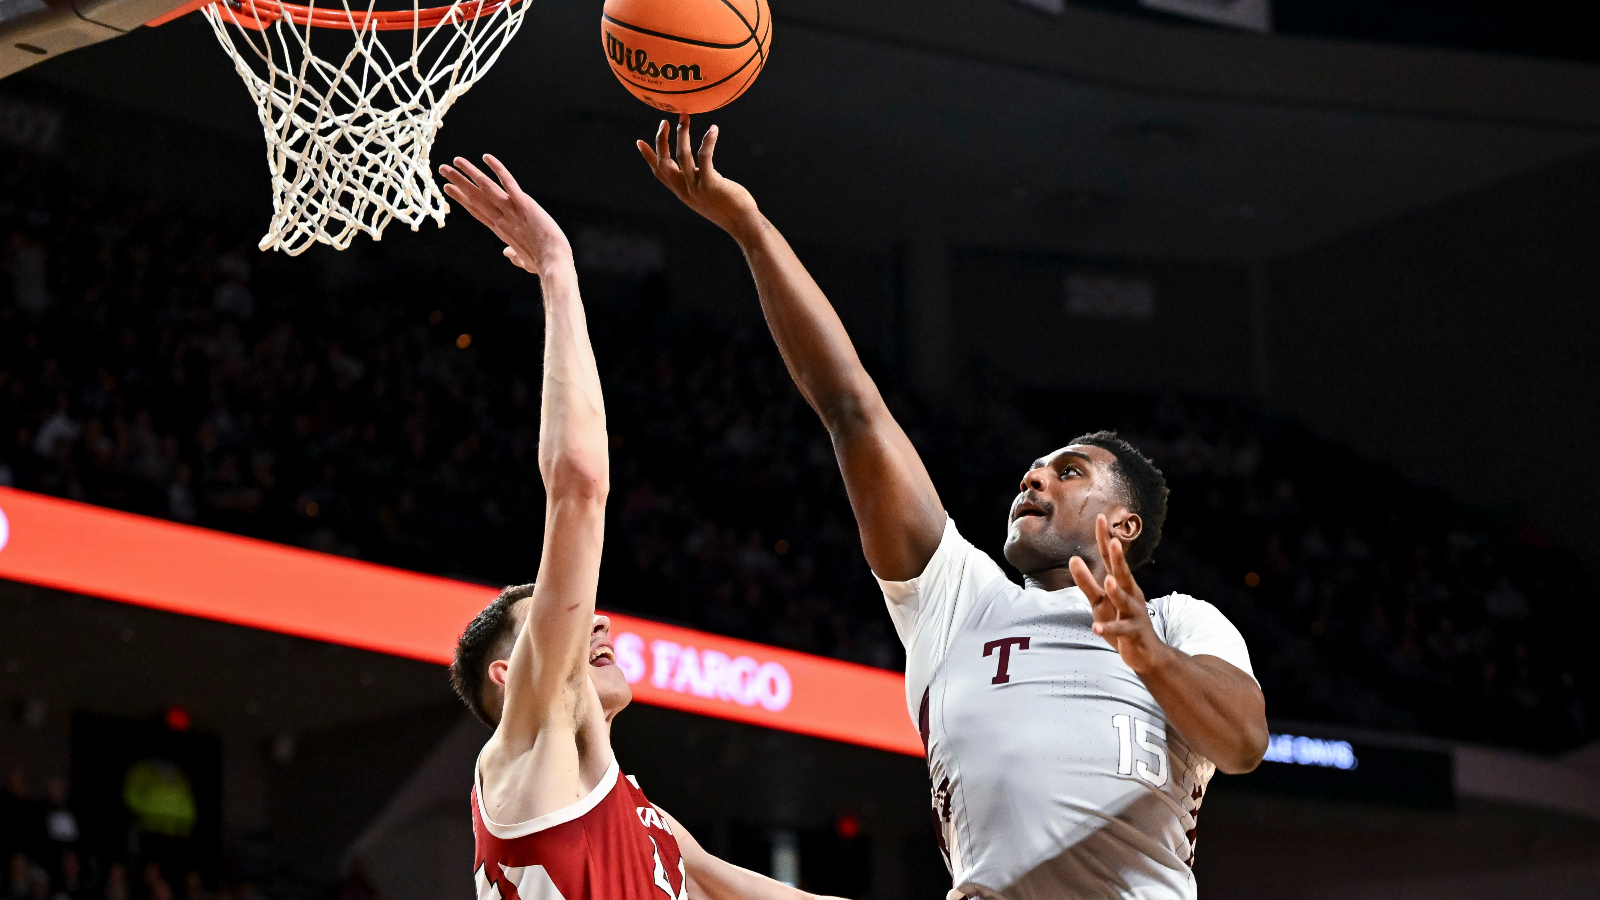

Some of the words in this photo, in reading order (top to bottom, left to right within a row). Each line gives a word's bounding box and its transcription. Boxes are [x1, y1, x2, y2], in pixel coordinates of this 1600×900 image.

[605, 29, 703, 82] Wilson
[651, 638, 793, 712] FARGO
[982, 636, 1031, 685] T
[1112, 713, 1168, 789] 15
